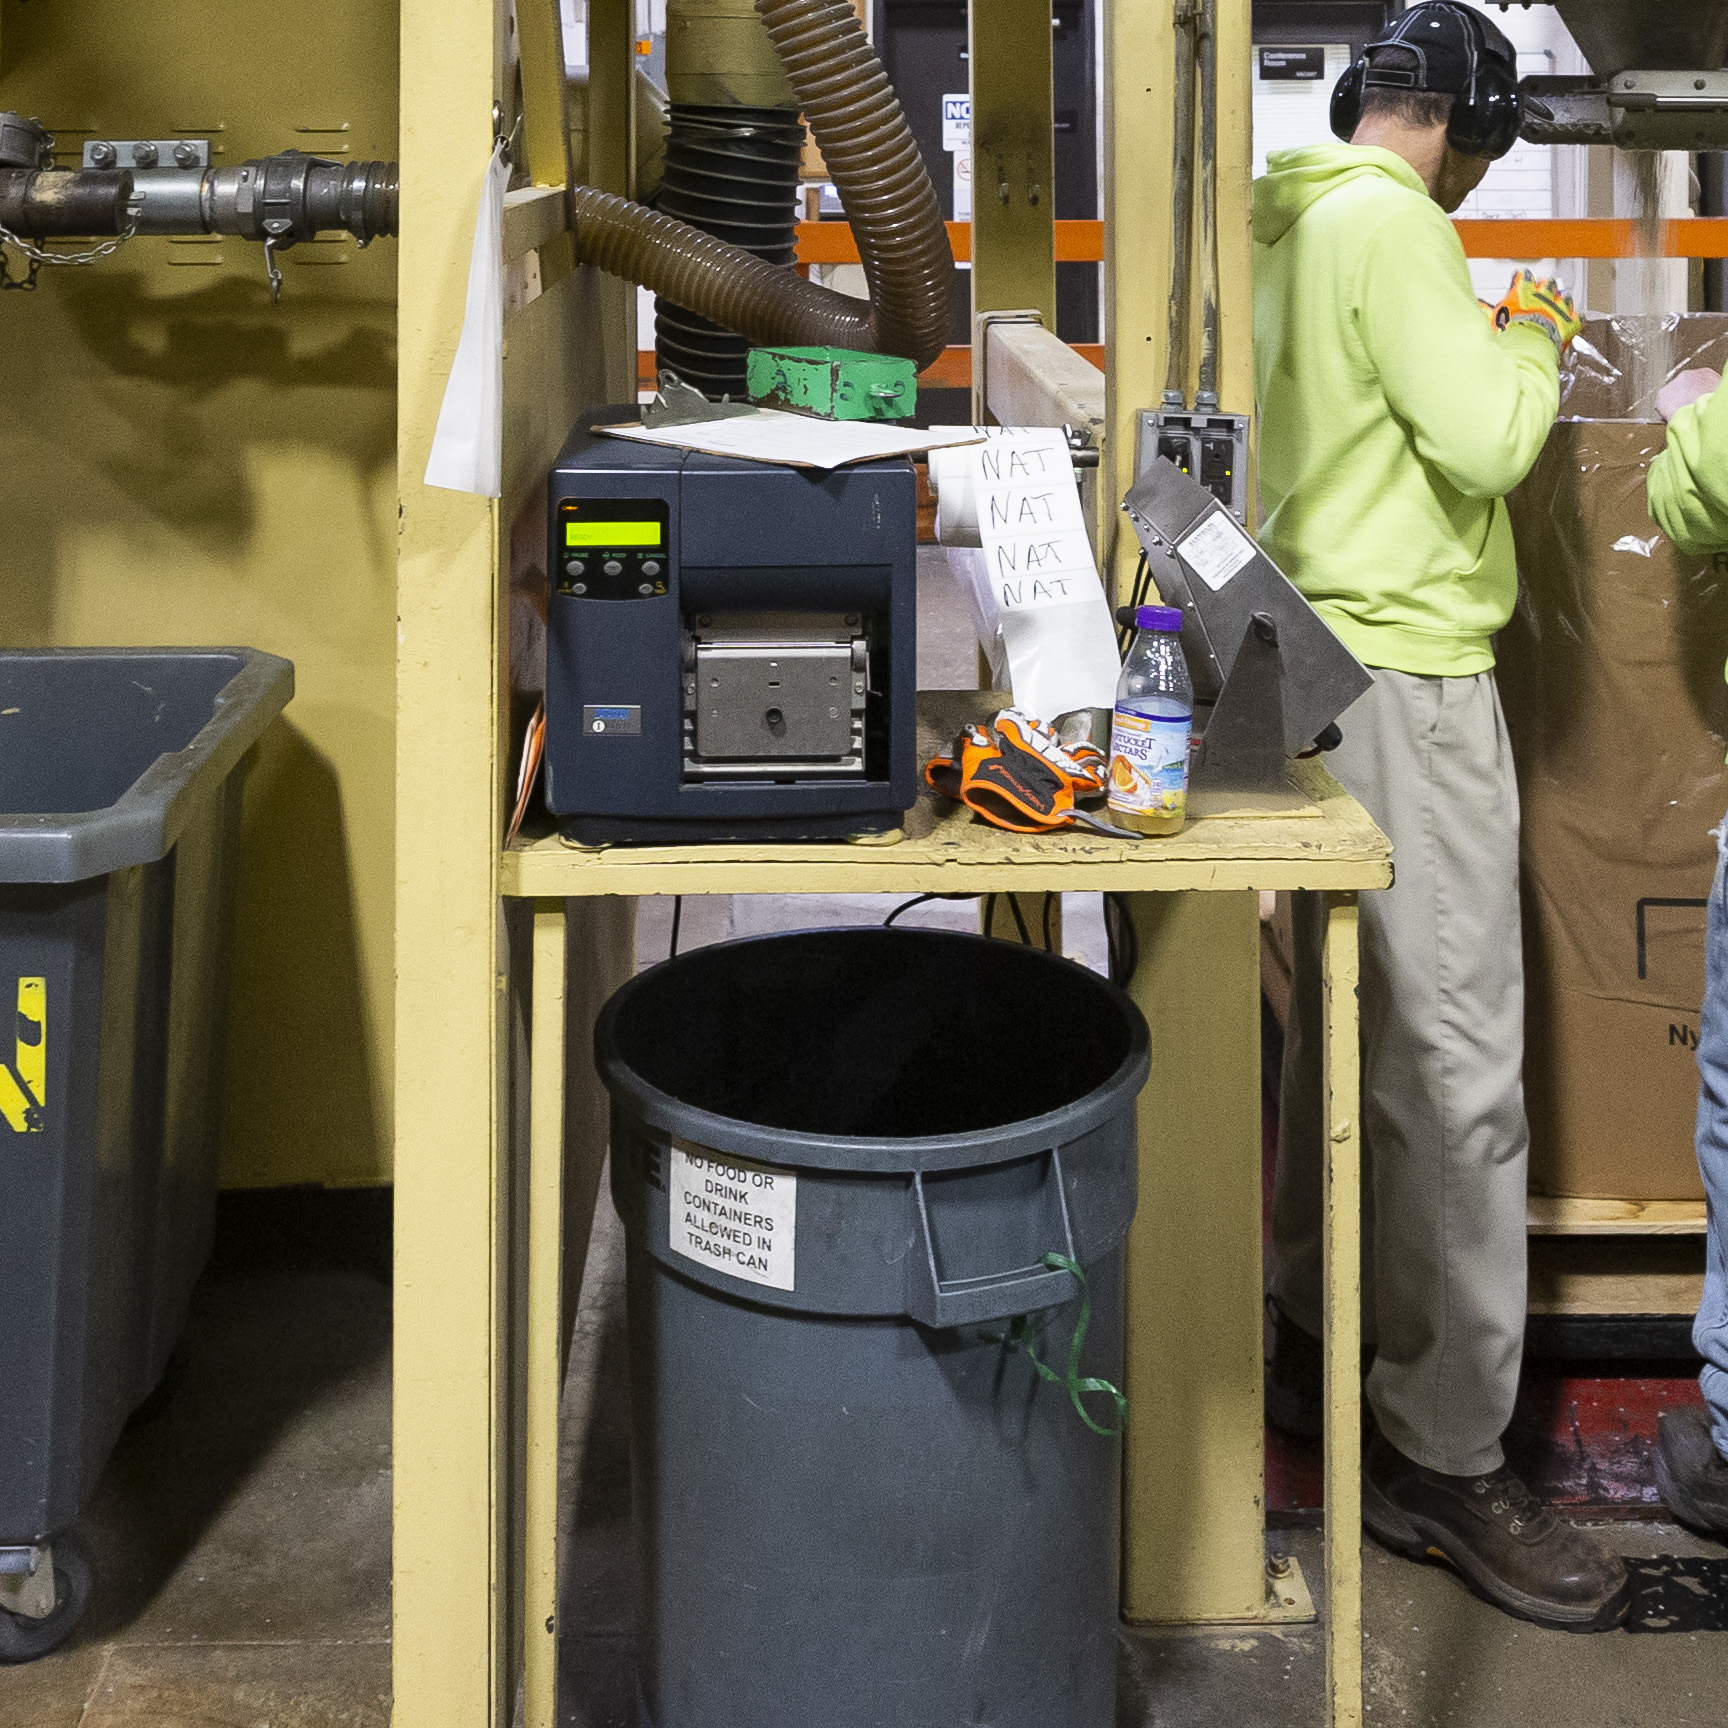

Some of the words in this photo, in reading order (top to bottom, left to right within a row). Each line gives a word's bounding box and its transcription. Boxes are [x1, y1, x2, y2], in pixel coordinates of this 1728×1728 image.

[981, 447, 1054, 480] NAT
[990, 491, 1054, 530] NAT
[997, 539, 1063, 577] NAT
[1002, 578, 1072, 607] NAT
[685, 1154, 704, 1169] NO
[707, 1160, 748, 1184] FOOD
[752, 1172, 775, 1191] OR
[684, 1191, 774, 1232] CONTAINERS
[705, 1179, 749, 1206] DRINK
[684, 1212, 752, 1247] ALLOWED
[757, 1235, 772, 1252] IN
[687, 1232, 732, 1261] TRASH
[736, 1251, 768, 1272] CAN
